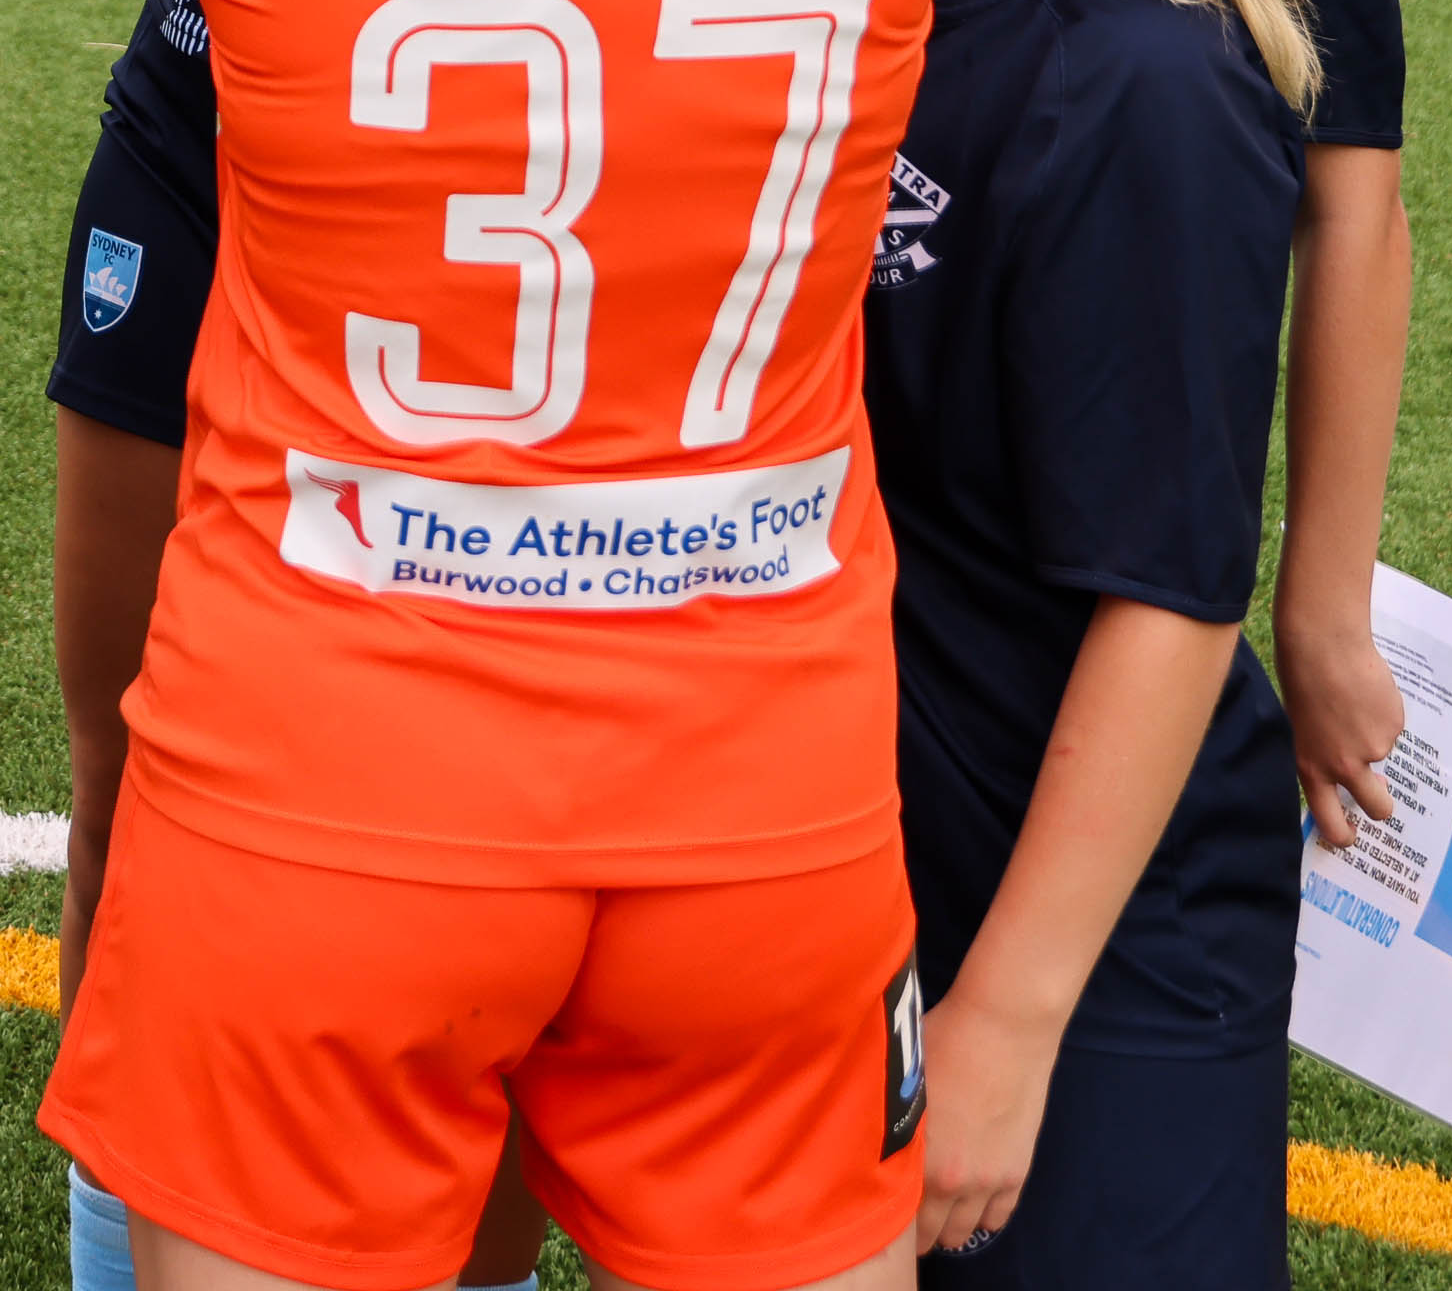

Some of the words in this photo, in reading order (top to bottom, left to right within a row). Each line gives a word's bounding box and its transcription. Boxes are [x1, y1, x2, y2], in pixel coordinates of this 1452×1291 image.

[895, 157, 942, 208] TRA
[92, 234, 136, 261] SYDNEY
[103, 253, 115, 265] FC
[390, 502, 491, 555] The
[507, 513, 738, 557] Athlete's
[750, 484, 826, 545] Foot
[393, 558, 568, 597] Burwood
[603, 546, 790, 596] Chatswood
[1360, 819, 1382, 840] GAME
[1381, 832, 1403, 852] HOME
[1354, 858, 1370, 874] THE
[1368, 845, 1404, 873] SELECTED
[1369, 867, 1387, 884] WON
[1409, 869, 1420, 883] AT
[1386, 877, 1406, 896] HAVE
[1405, 888, 1420, 905] YOU
